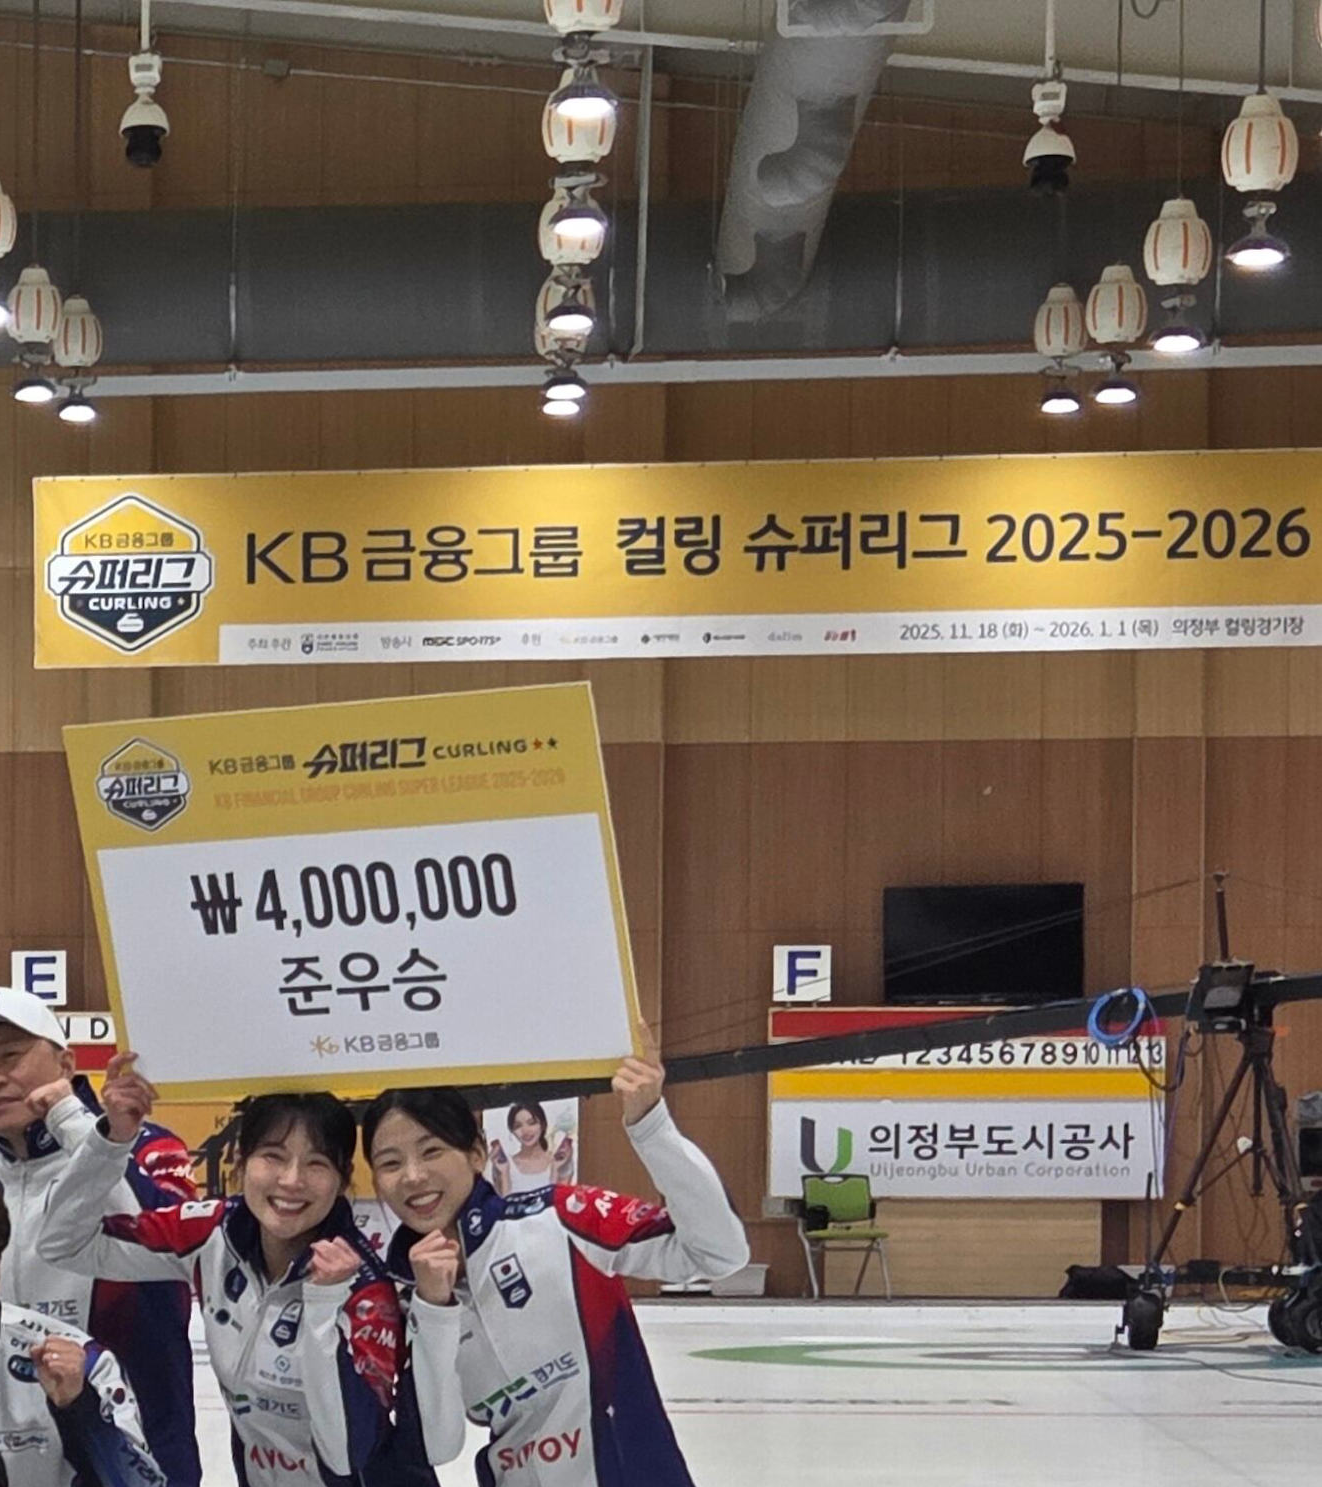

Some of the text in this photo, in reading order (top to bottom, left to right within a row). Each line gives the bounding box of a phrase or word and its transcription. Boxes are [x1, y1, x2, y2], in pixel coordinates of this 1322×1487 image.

[245, 506, 1312, 585] KB금융그룹 컬링 슈퍼리그 2025-2026
[57, 557, 197, 595] 슈퍼리그
[88, 595, 173, 611] CURLING
[899, 624, 943, 641] 2025.
[1171, 617, 1220, 637] 의정부
[302, 736, 426, 778] 슈퍼리그
[432, 738, 528, 759] CURLING
[103, 774, 180, 799] 슈퍼리그
[24, 956, 57, 1000] E
[278, 947, 448, 1017] 준우승
[787, 950, 822, 996] F
[867, 1122, 1136, 1161] 의정부도시공사
[869, 1162, 1131, 1181] Uijeongbu Urban Corporation
